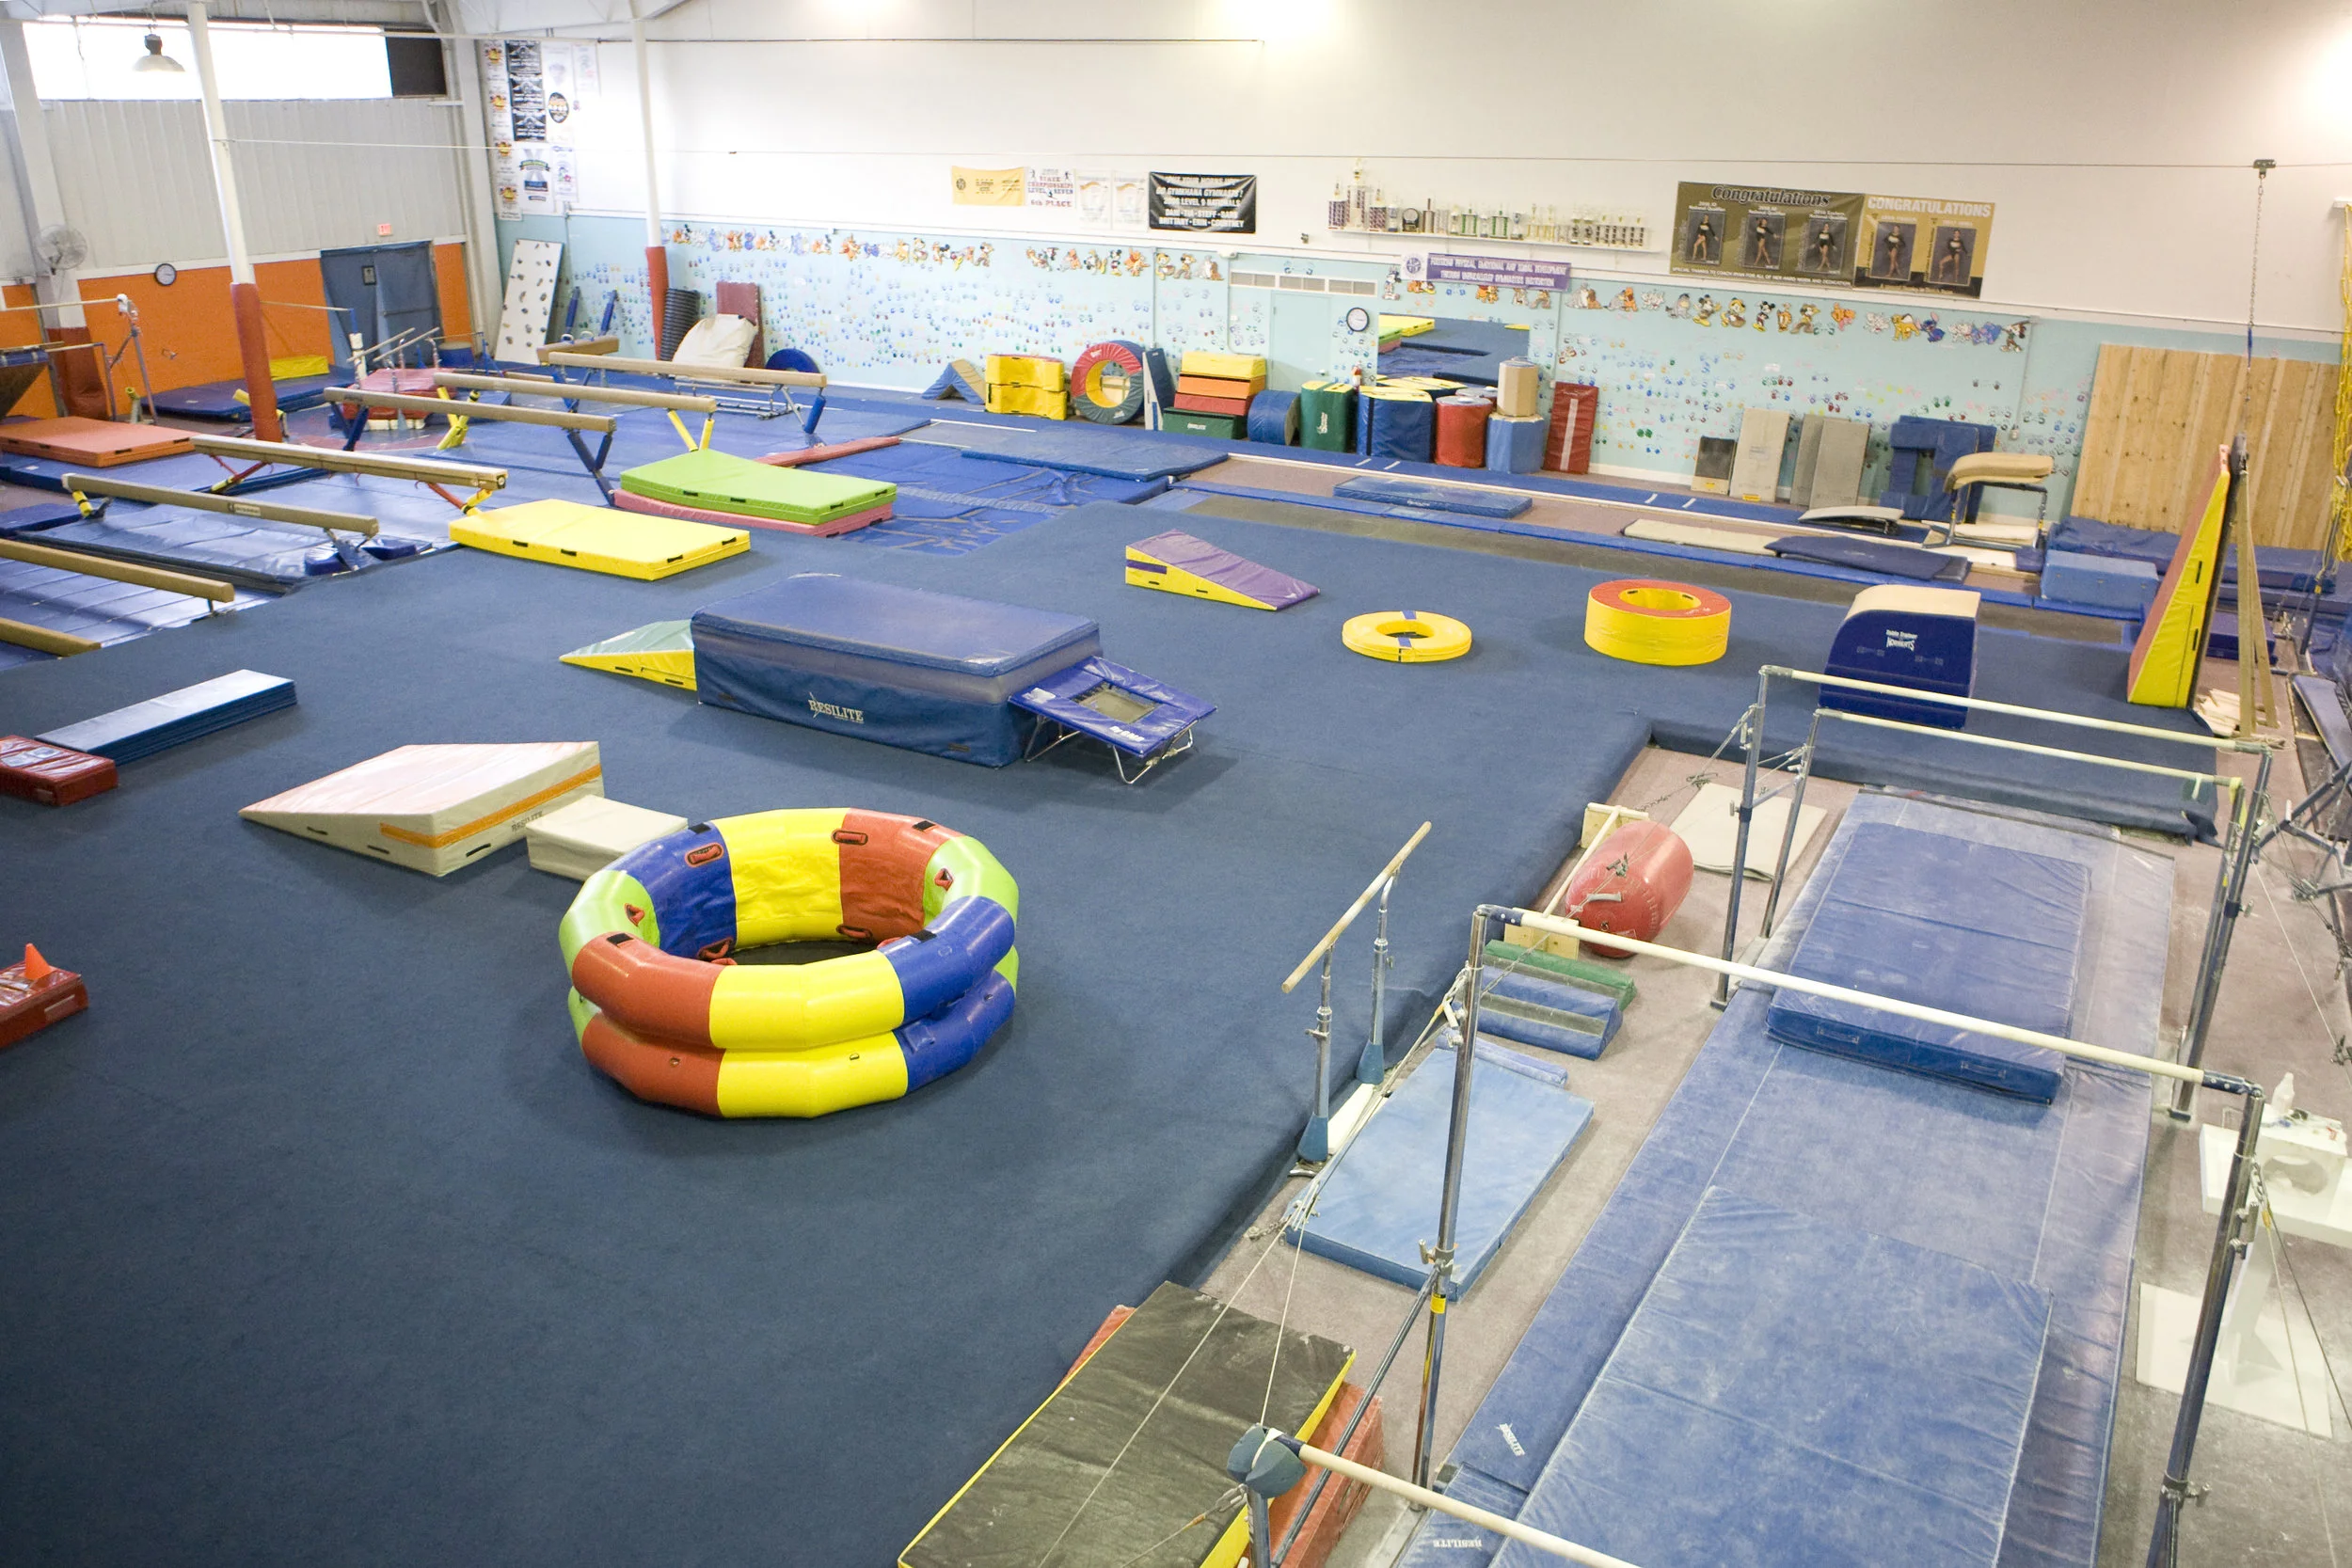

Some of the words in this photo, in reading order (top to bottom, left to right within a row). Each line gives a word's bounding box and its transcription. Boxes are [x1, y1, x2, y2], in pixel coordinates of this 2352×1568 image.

[1181, 198, 1200, 206] LEVEL
[1712, 186, 1830, 206] Congratulations
[1867, 197, 1991, 216] CONGRATULATIONS
[808, 699, 864, 721] RESILITE
[1432, 1538, 1483, 1549] RESILITE
